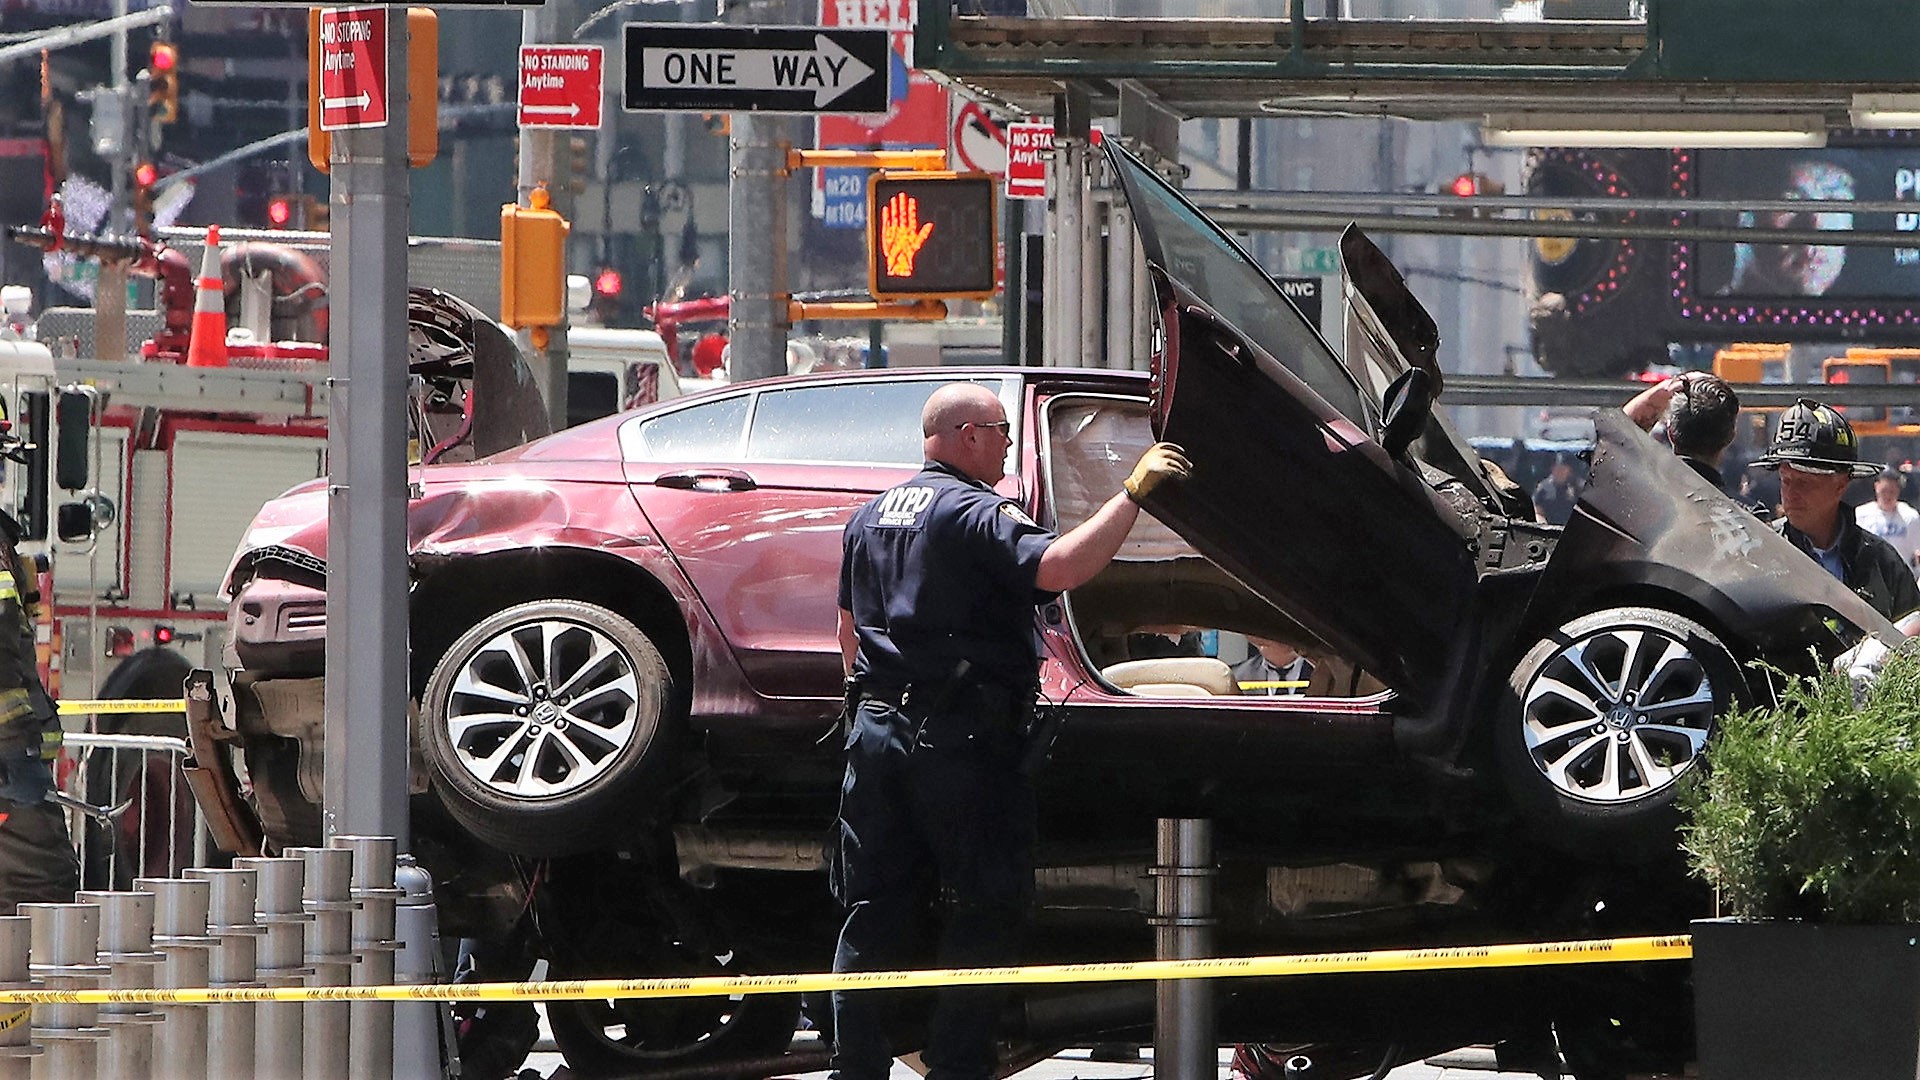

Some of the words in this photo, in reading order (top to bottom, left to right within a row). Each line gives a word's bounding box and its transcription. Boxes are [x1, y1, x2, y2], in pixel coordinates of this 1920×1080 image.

[325, 22, 336, 44] NO
[337, 20, 371, 42] STOPPING
[325, 49, 355, 75] Anytime
[525, 55, 539, 71] NO
[541, 55, 589, 71] STANDING
[664, 54, 736, 84] ONE
[772, 55, 848, 87] WAY
[525, 73, 565, 91] Anytime
[1013, 133, 1029, 148] NO
[1031, 133, 1055, 148] STA
[1283, 281, 1316, 297] NYC
[1780, 420, 1812, 442] 54
[877, 486, 935, 513] NYPD
